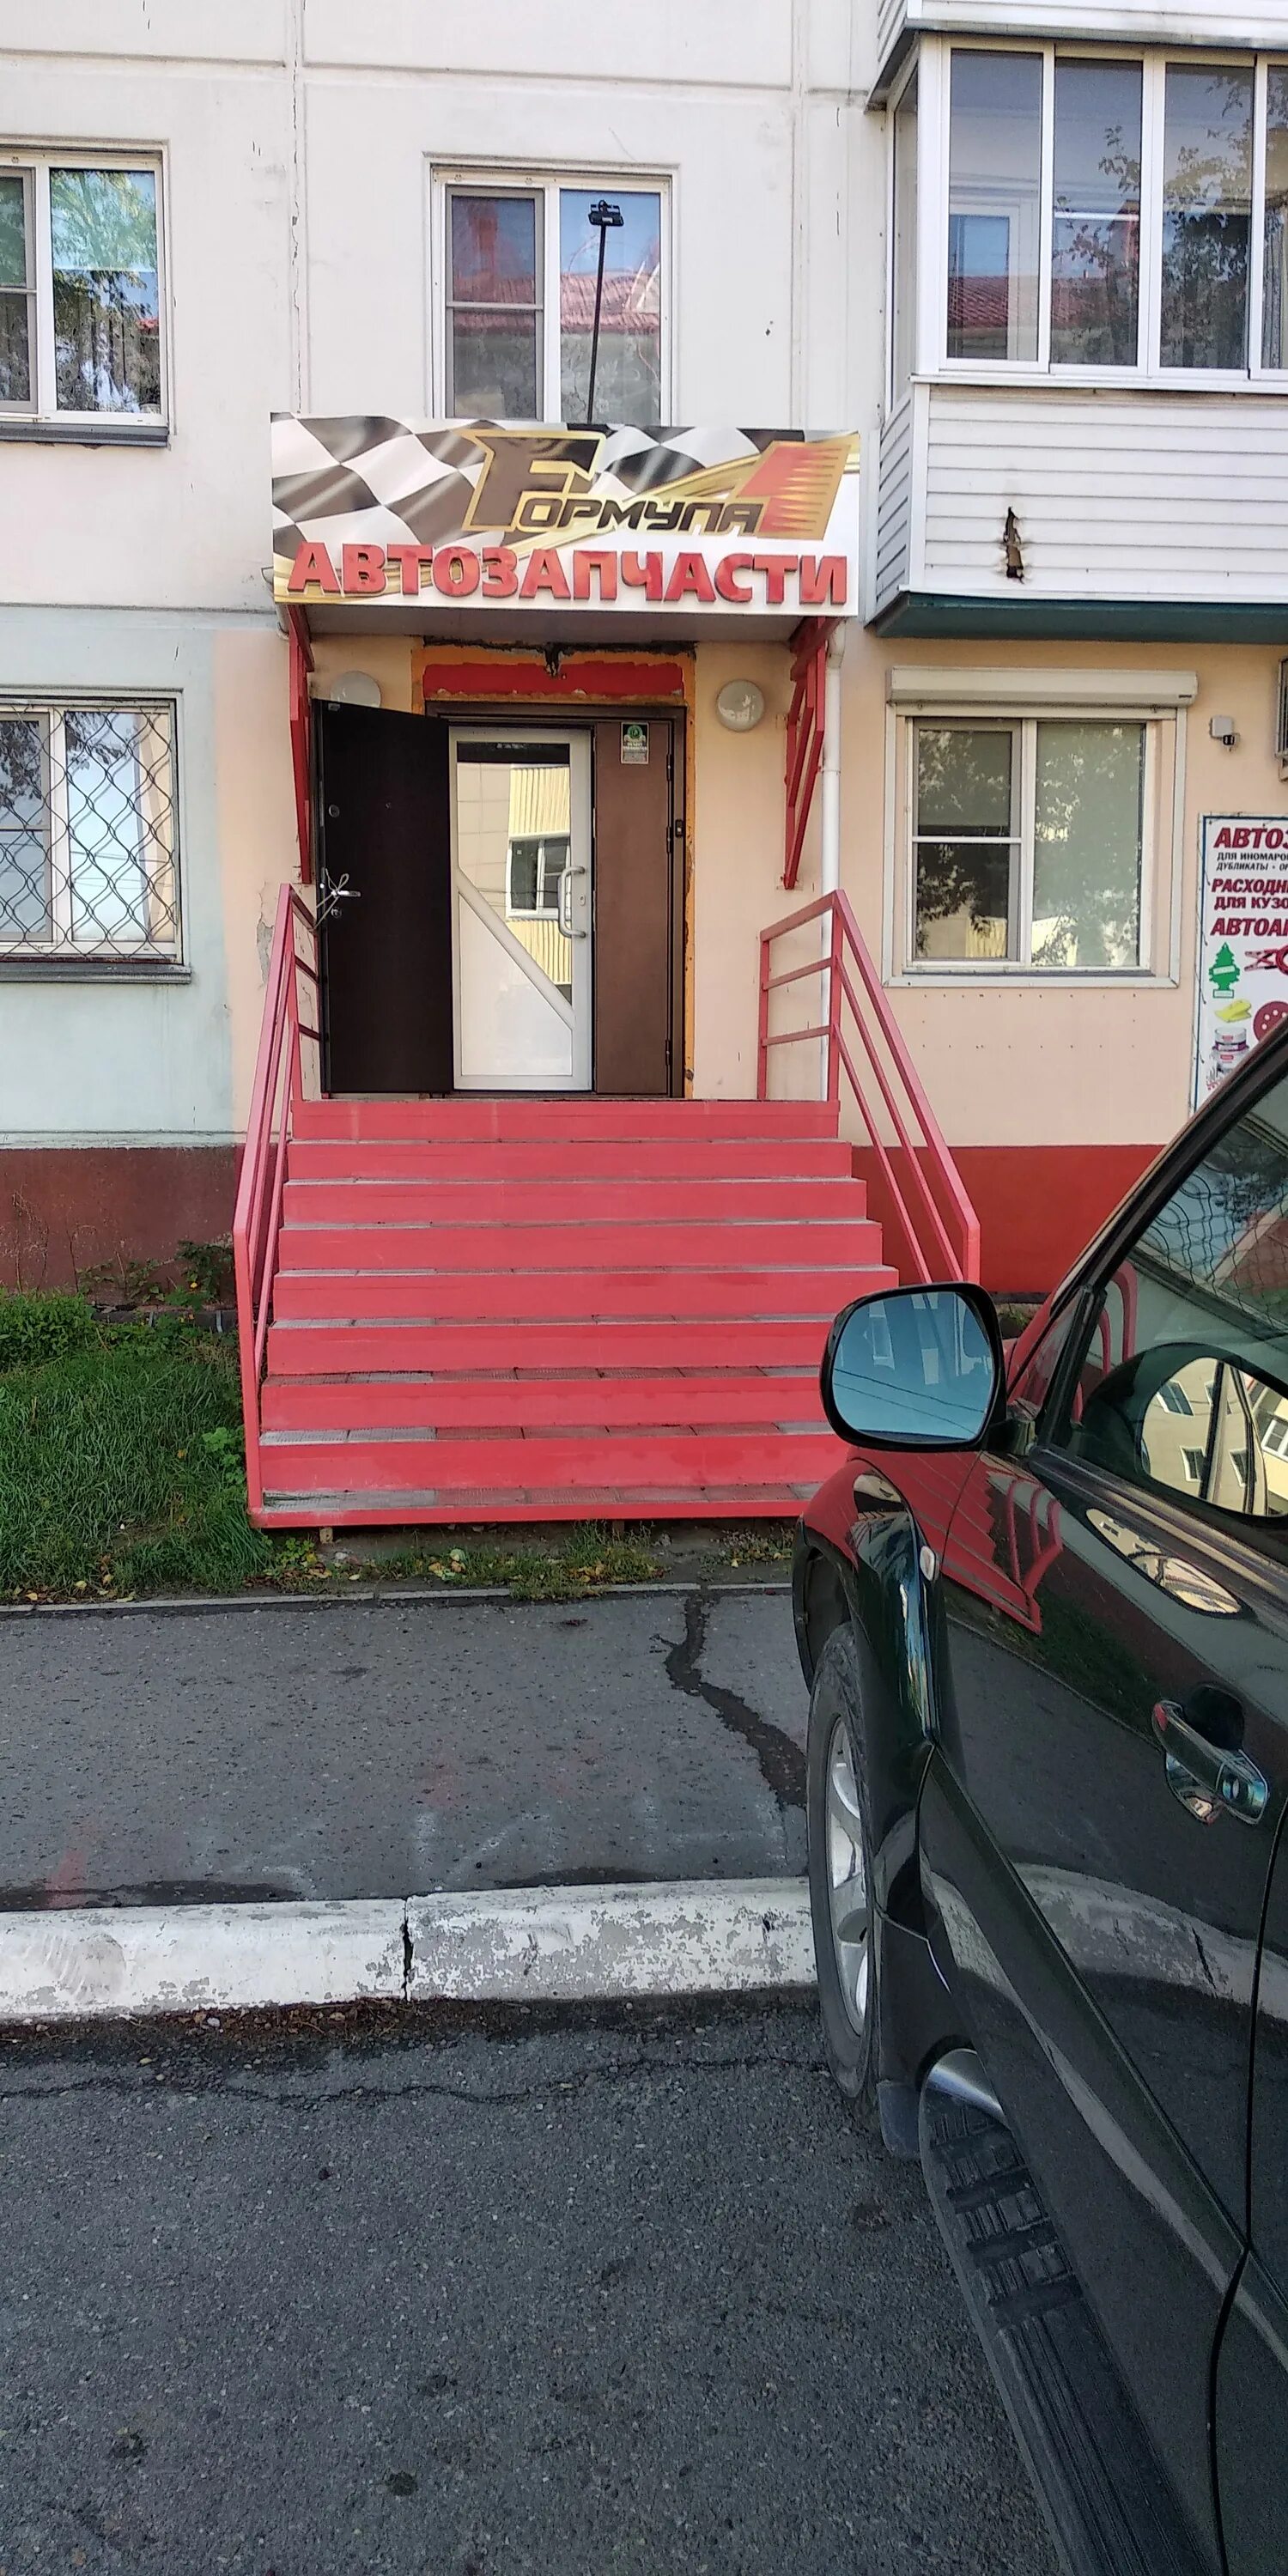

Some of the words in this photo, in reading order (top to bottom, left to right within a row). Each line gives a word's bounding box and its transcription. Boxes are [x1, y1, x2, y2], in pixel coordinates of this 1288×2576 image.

[287, 541, 848, 606] АВТОЗАПЧАСТИ
[1216, 852, 1237, 861] ДЛЯ
[1240, 852, 1288, 861] ИНОМАРО
[1216, 862, 1268, 872] ДУБЛИКАТЫ
[1212, 878, 1288, 896] РАСХОДН
[1214, 896, 1246, 910] ДЛЯ
